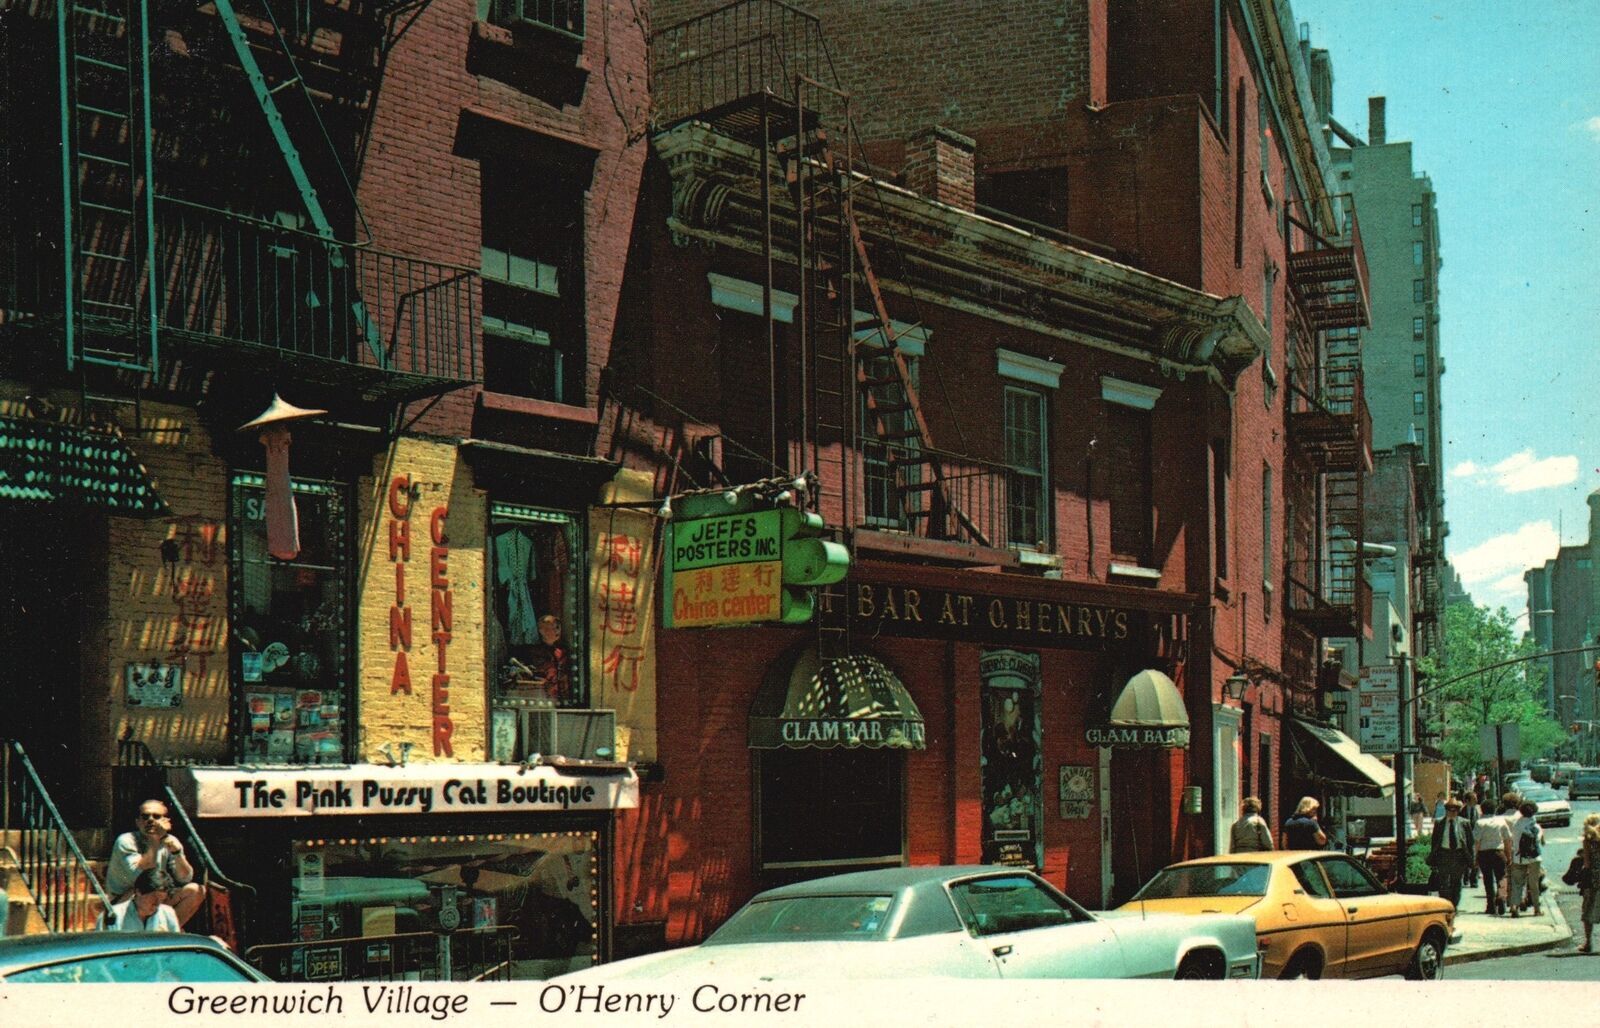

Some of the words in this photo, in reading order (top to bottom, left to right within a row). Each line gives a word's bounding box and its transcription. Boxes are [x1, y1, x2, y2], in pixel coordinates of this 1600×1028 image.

[692, 518, 757, 543] JEFFS
[676, 538, 750, 563] POSTERS
[755, 537, 778, 557] INC.
[388, 475, 412, 696] CHINA
[673, 587, 719, 620] China
[858, 584, 923, 622] BAR
[938, 593, 973, 626] AT
[430, 505, 454, 758] CENTER
[782, 720, 840, 742] CLAM
[845, 721, 884, 743] BAR
[1085, 729, 1138, 743] CLAM
[1143, 729, 1177, 744] BAR
[234, 780, 287, 808] The
[296, 779, 352, 808] Pink
[362, 779, 433, 812] Pussy
[443, 779, 487, 805] Cat
[496, 778, 595, 809] Boutique
